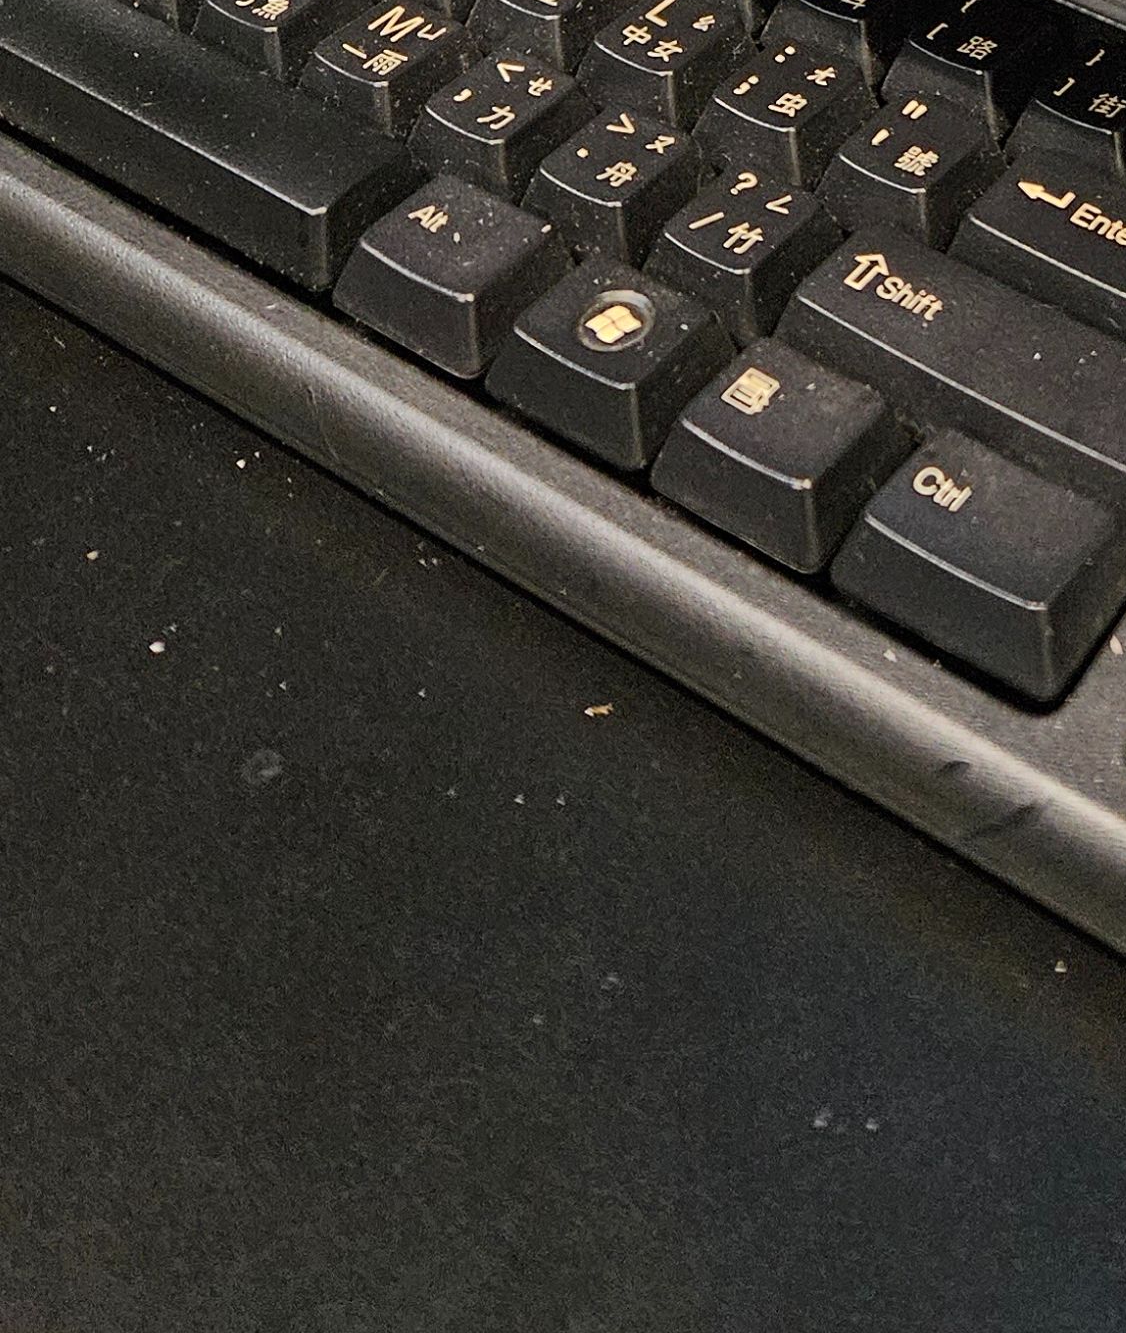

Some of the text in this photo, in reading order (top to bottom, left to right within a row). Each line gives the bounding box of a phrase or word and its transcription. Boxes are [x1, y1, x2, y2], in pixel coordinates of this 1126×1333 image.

[367, 5, 427, 44] M
[956, 35, 998, 61] 路
[767, 92, 808, 118] 虫
[407, 204, 449, 233] Alt
[723, 222, 764, 254] 竹
[875, 276, 943, 321] Shift
[913, 466, 972, 512] Ctrl
